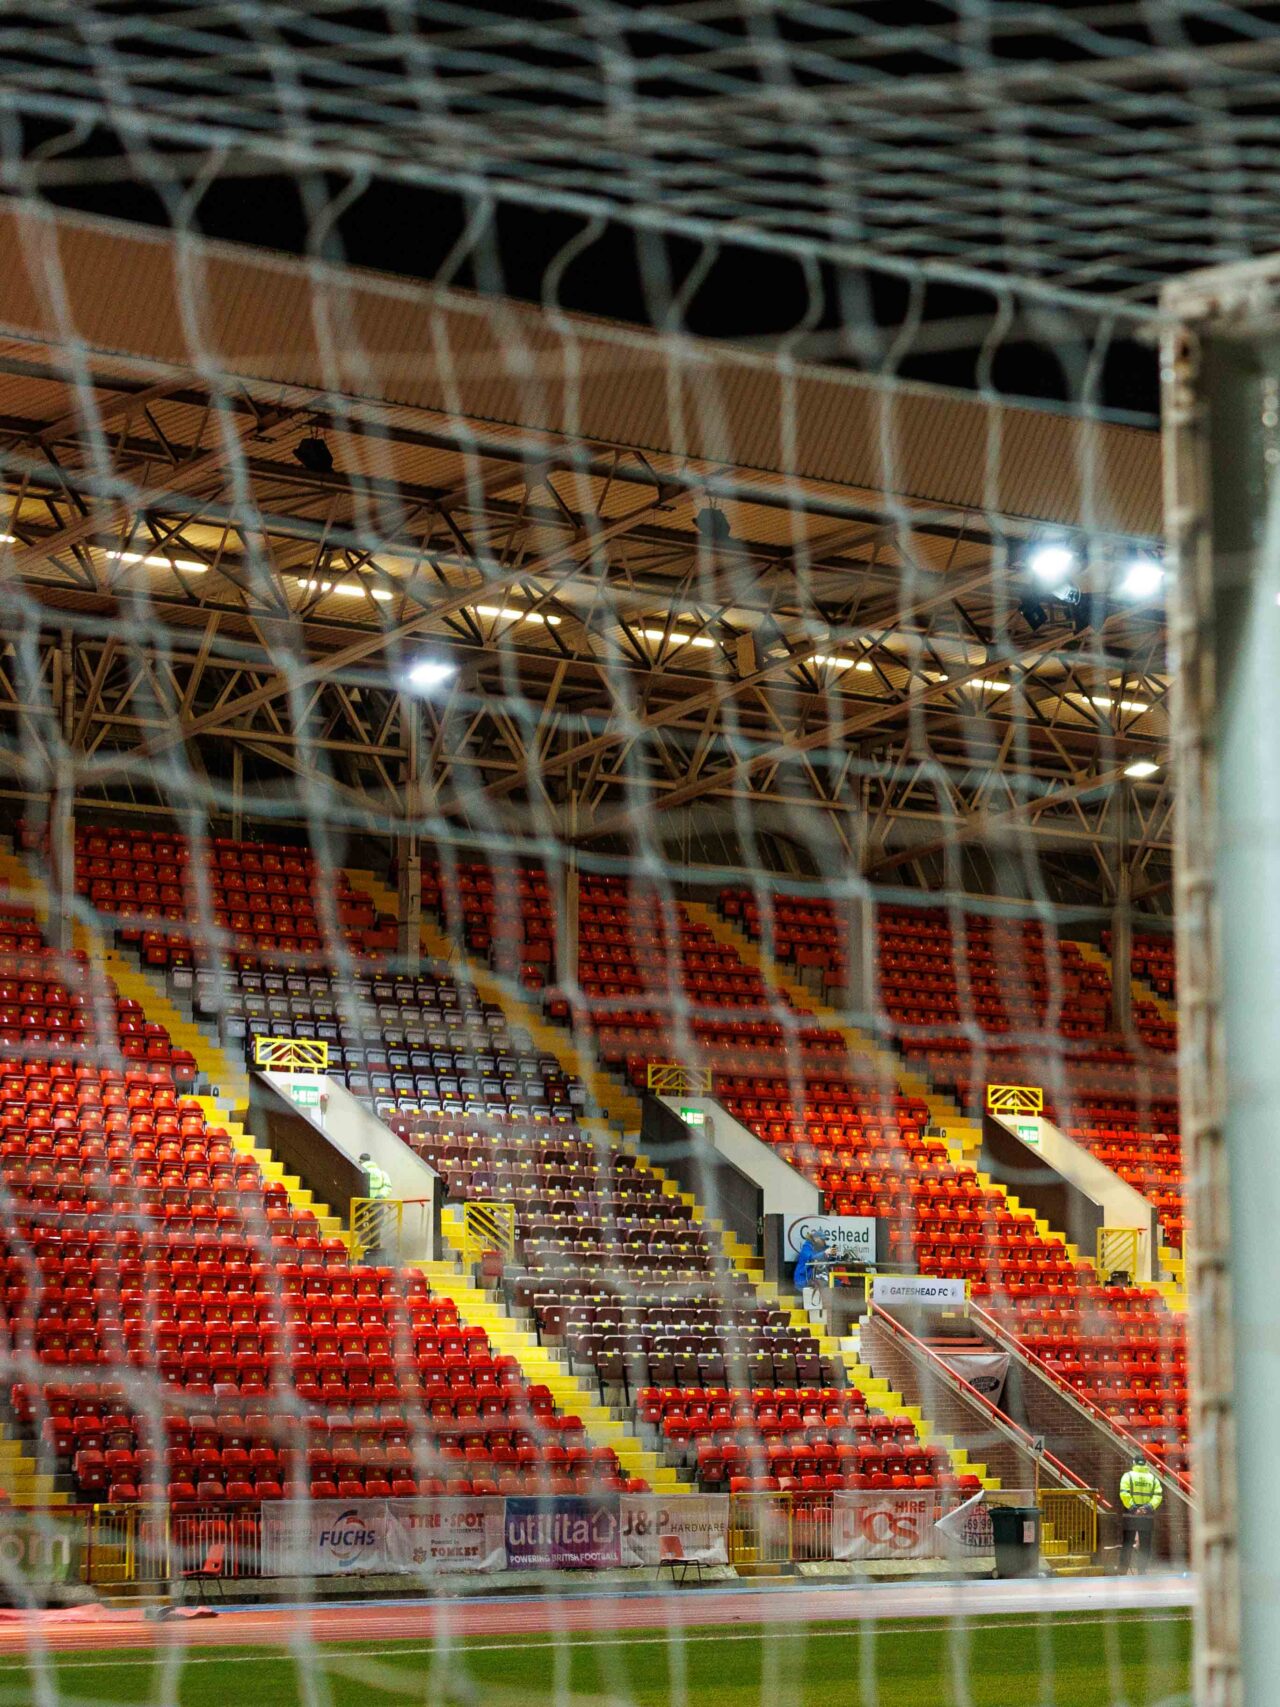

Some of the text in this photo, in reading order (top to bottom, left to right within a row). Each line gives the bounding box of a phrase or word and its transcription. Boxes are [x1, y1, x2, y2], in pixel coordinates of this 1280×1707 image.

[800, 1224, 869, 1243] Geshead
[890, 1286, 949, 1297] GATESHEAD FC
[1035, 1440, 1042, 1452] 4
[895, 1501, 926, 1513] HIRE
[509, 1513, 589, 1545] utilita
[623, 1510, 725, 1536] J&P HARDWARE
[320, 1530, 376, 1547] FUCHS
[510, 1552, 618, 1563] POWERING BRITISH FOOTBALL
